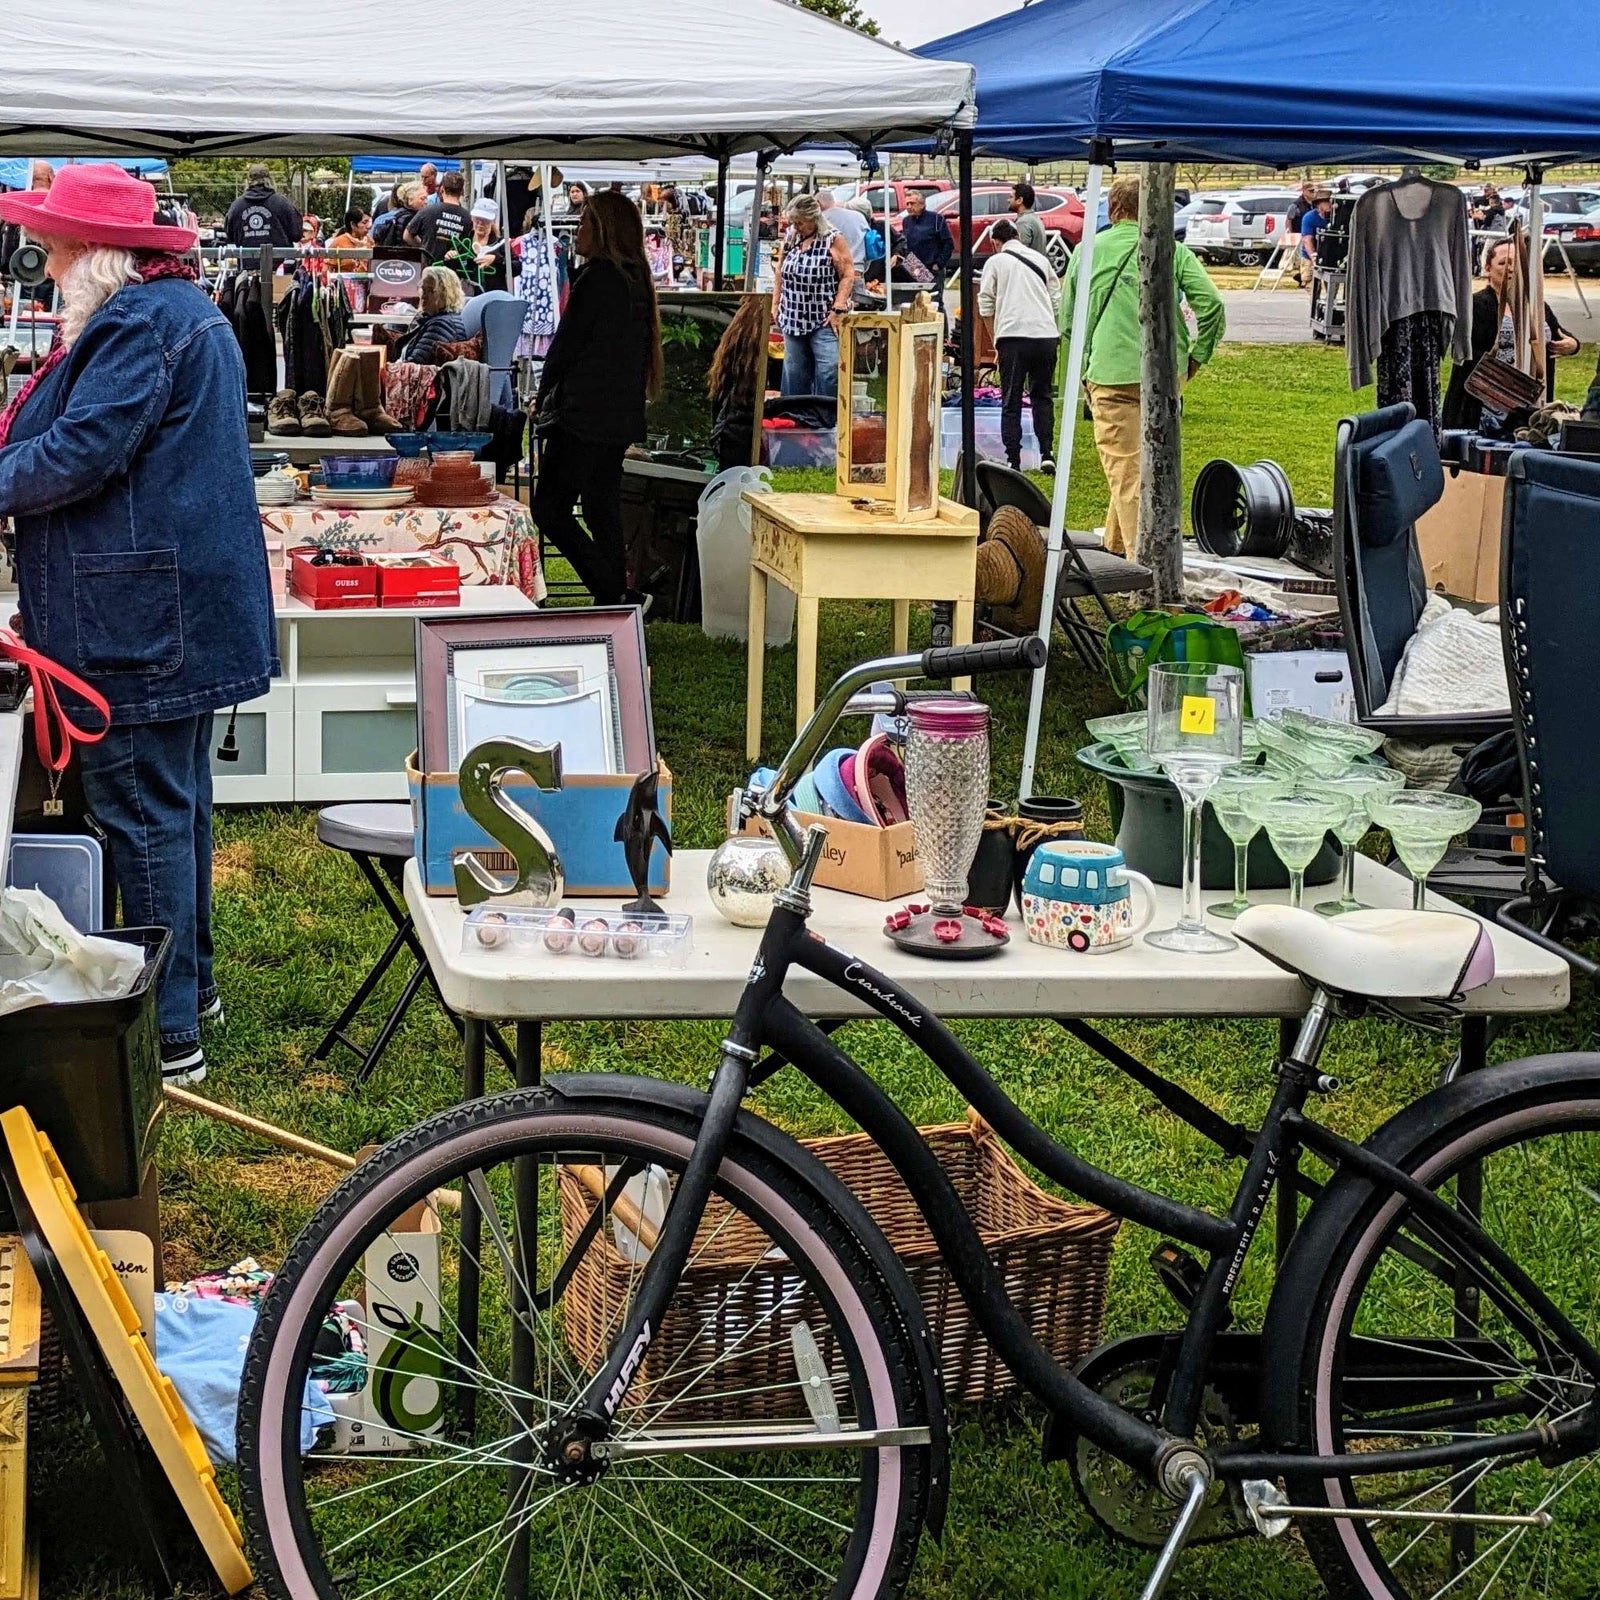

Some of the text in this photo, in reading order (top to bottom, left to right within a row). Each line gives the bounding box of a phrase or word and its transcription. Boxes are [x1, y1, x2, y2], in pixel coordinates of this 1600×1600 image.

[435, 219, 464, 231] FREEDOM
[442, 211, 462, 222] TRUTH
[335, 579, 359, 587] GUESS
[453, 735, 564, 911] S
[844, 962, 921, 1028] Cranbrook
[1222, 1166, 1276, 1294] PERFECT FIT FRAME
[603, 1319, 651, 1417] HUFFY
